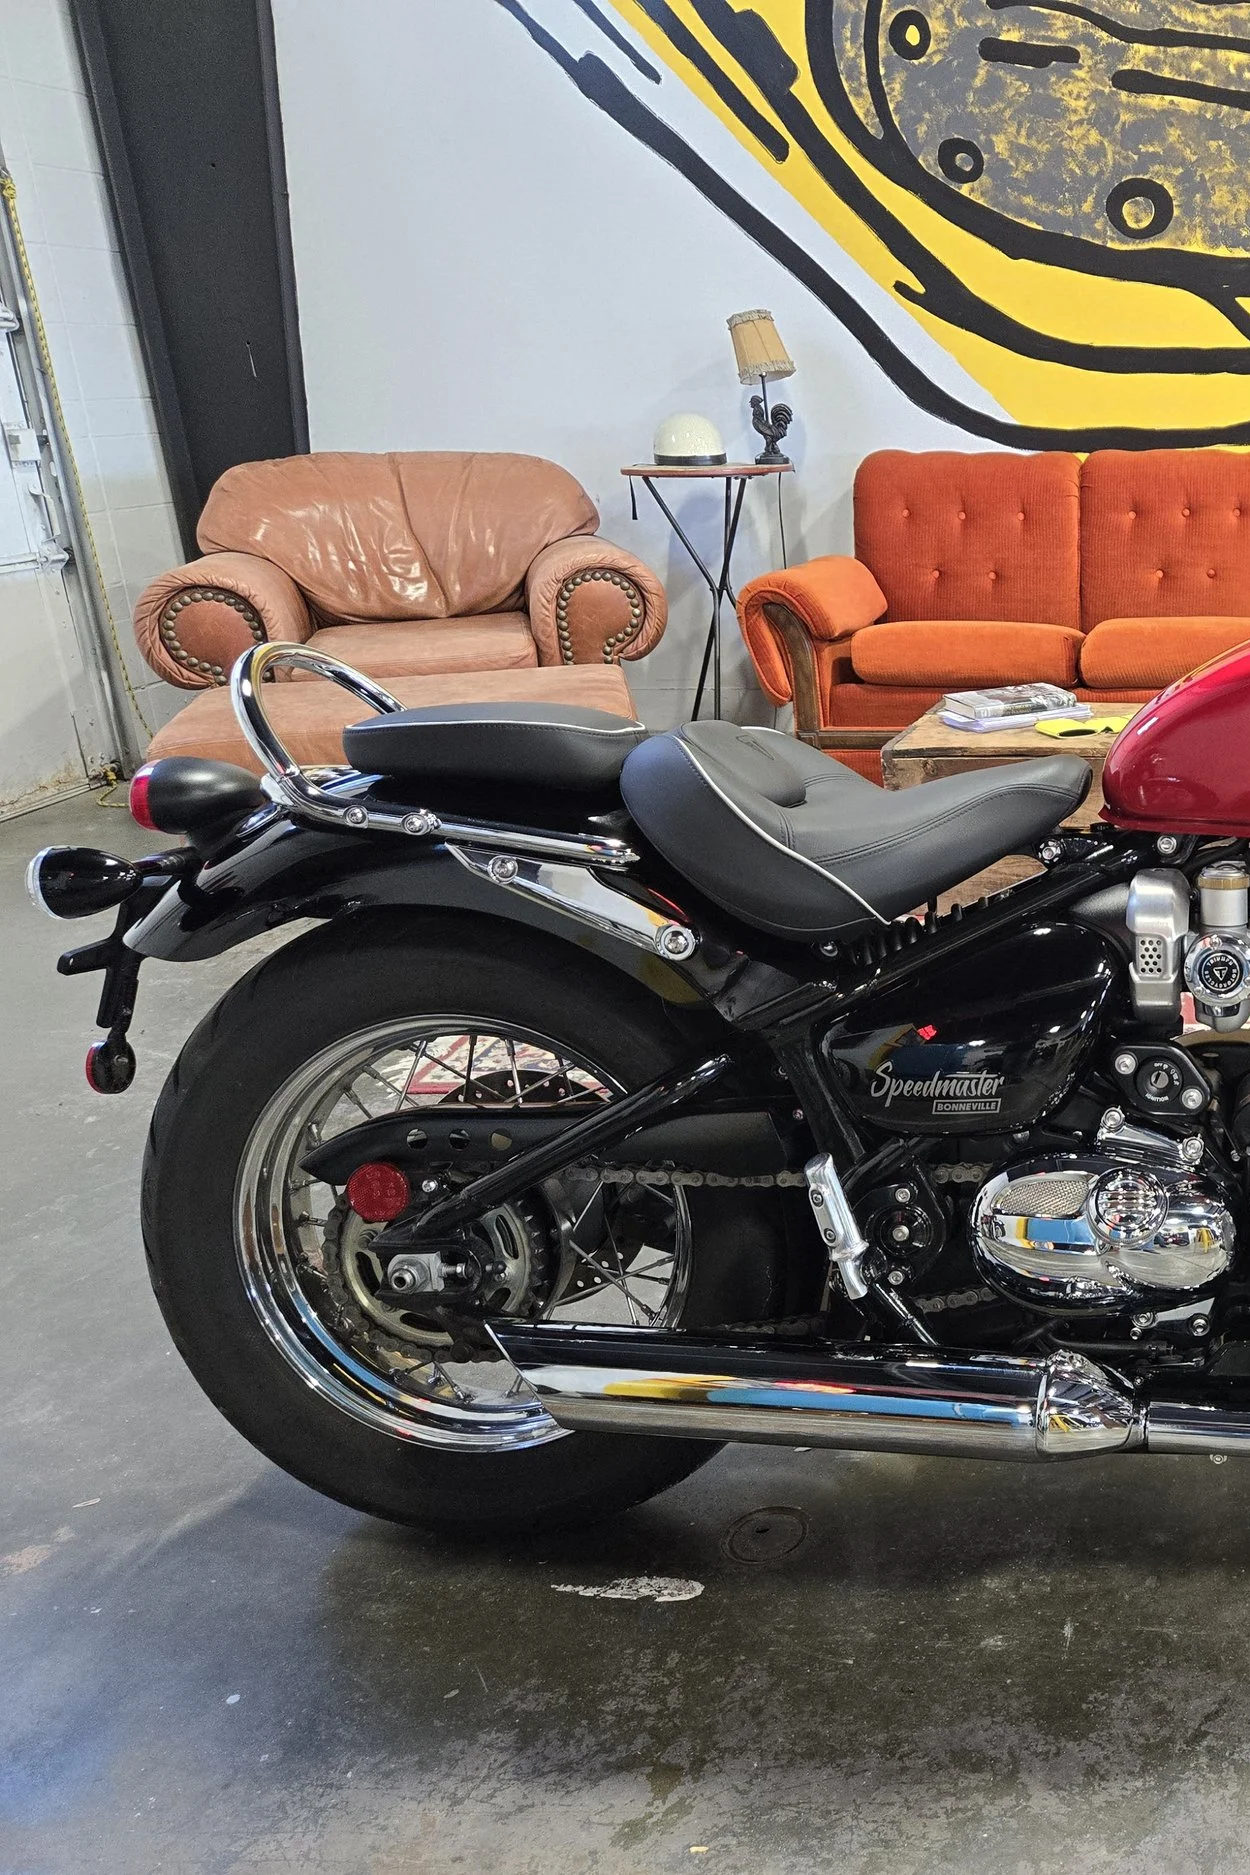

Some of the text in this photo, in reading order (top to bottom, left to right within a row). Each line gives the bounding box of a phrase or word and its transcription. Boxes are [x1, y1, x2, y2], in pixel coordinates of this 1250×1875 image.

[1204, 956, 1238, 989] TRIUMPH MOTORCYCLES
[871, 1060, 1005, 1107] Speedmaster
[936, 1101, 997, 1112] BONNEVILLE
[1145, 1092, 1169, 1102] IGNITION
